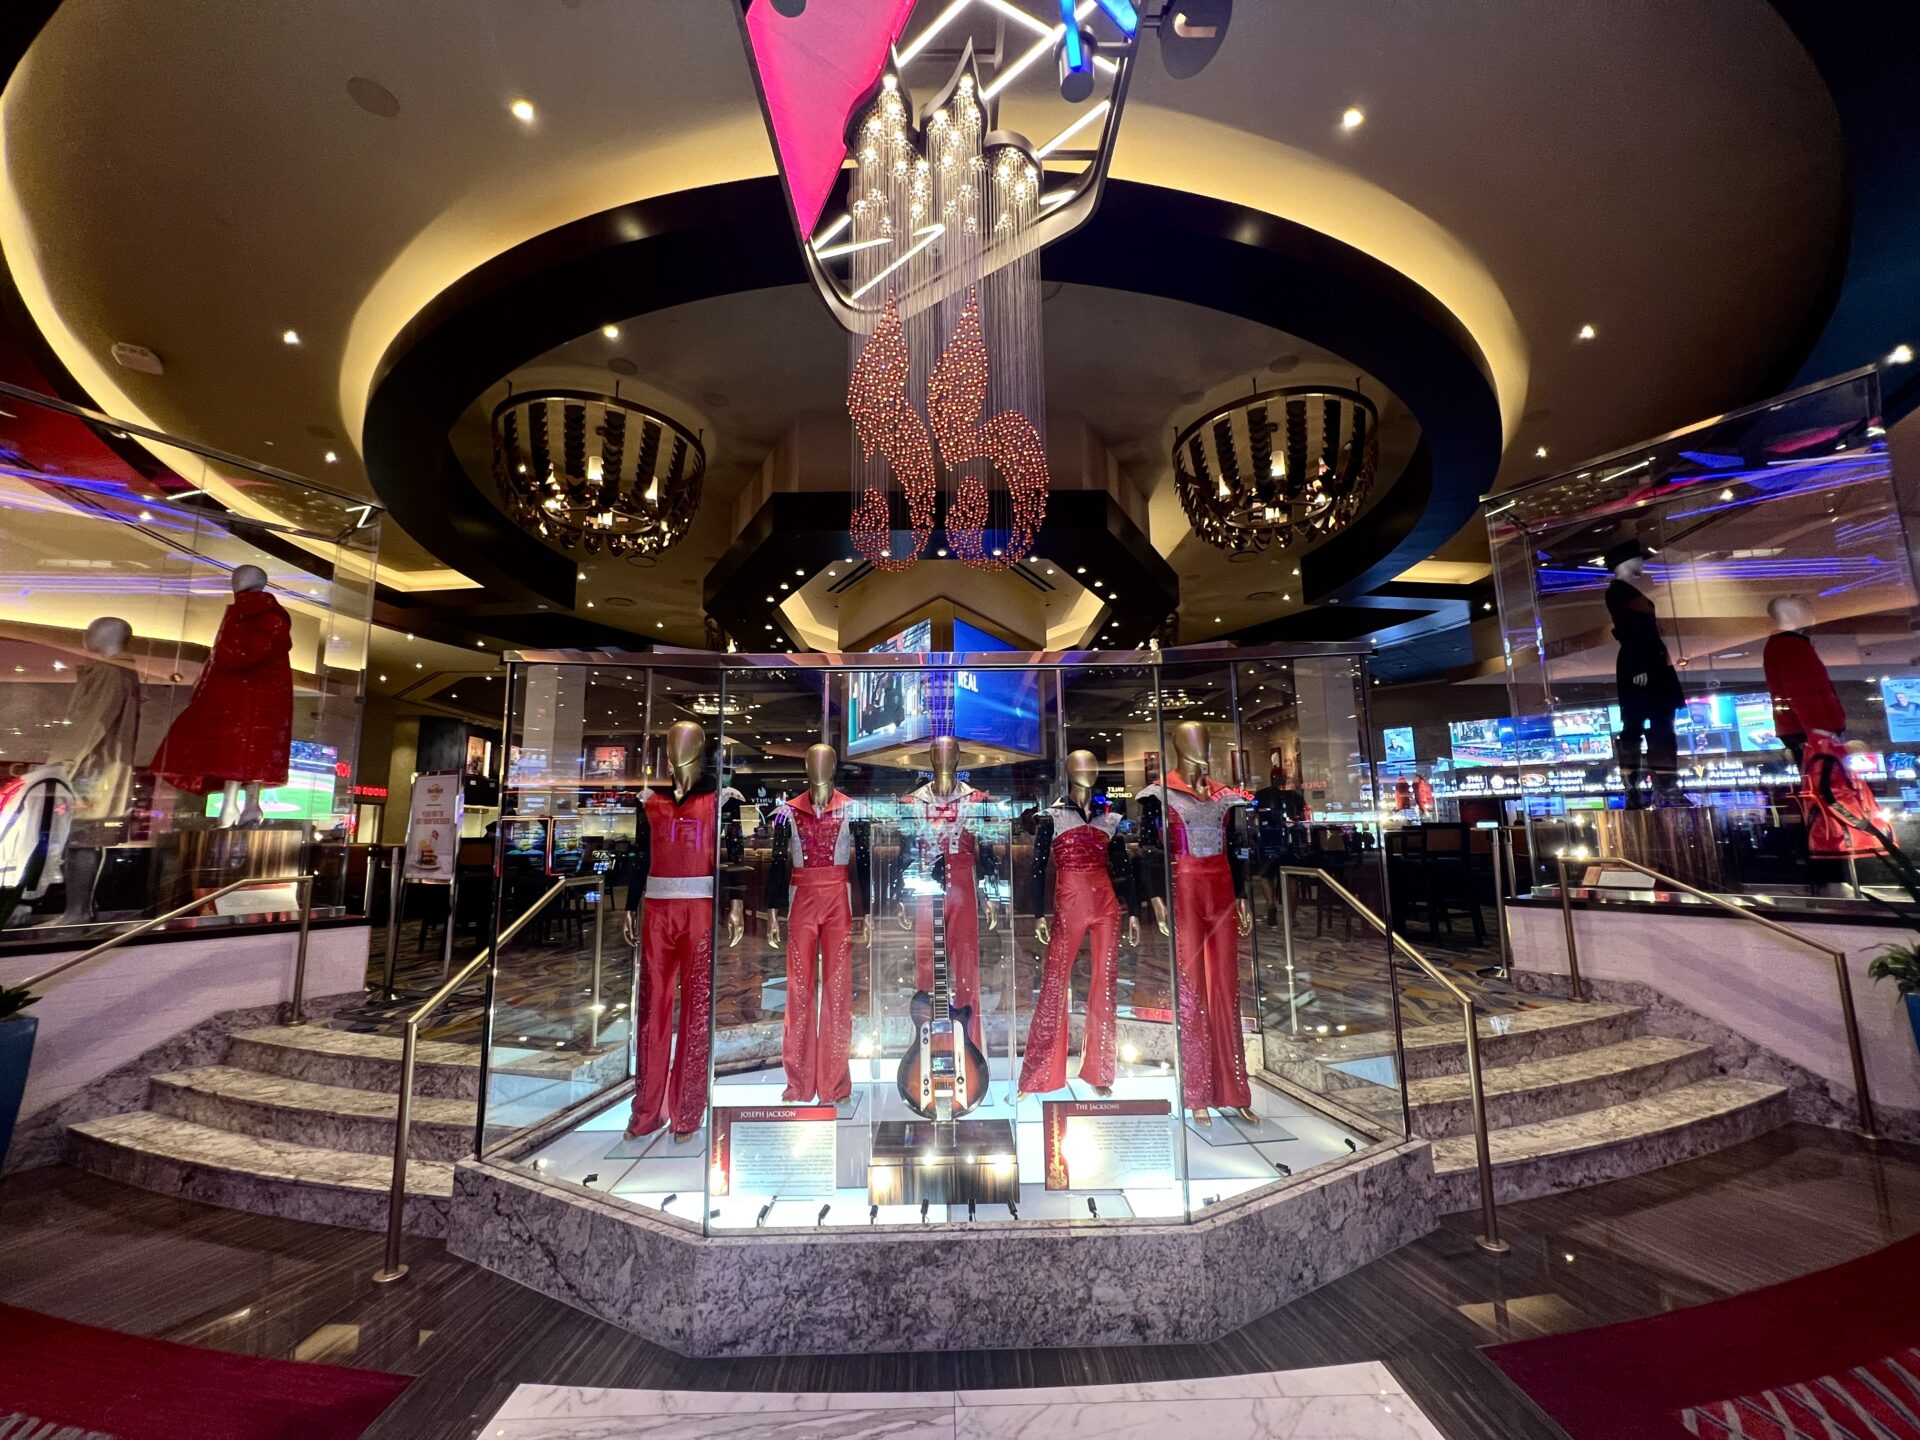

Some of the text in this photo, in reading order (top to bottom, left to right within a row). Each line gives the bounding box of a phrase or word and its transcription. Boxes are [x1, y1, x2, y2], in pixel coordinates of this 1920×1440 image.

[957, 671, 979, 693] REAL
[1709, 769, 1747, 778] Arizona
[1075, 1103, 1120, 1111] THE JACKSONS
[740, 1110, 797, 1119] JOSEPH JACKSON
